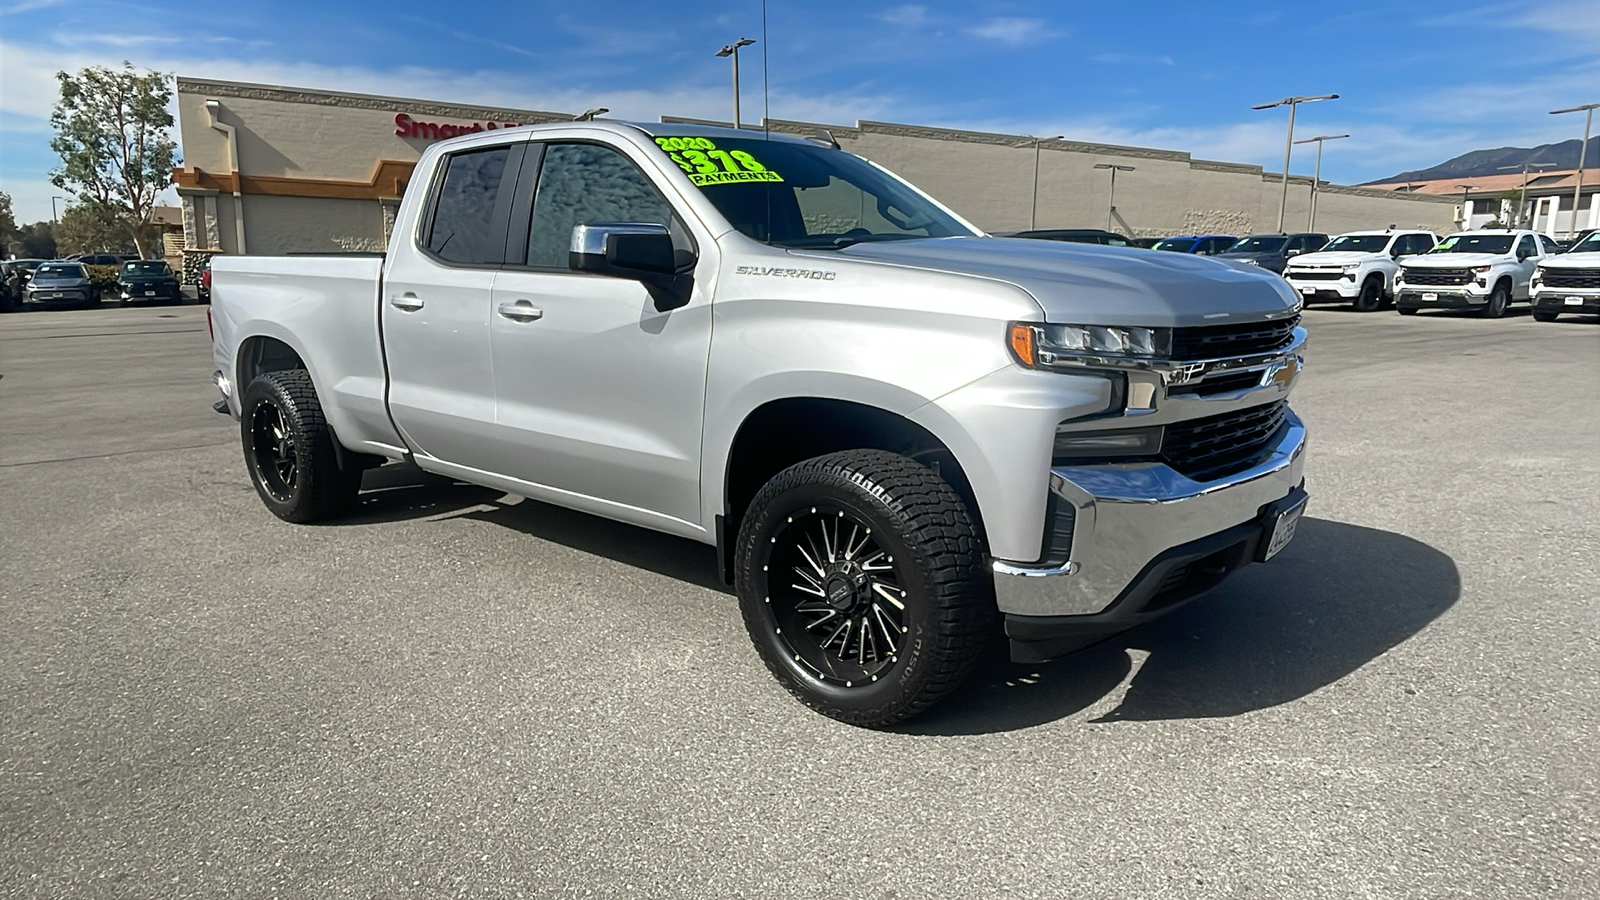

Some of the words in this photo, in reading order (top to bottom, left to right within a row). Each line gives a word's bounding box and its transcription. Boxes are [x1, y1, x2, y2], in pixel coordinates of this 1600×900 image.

[655, 137, 716, 151] 2020
[692, 172, 778, 184] PAYMENTS
[735, 265, 837, 281] SILVERADO
[899, 624, 923, 686] ARISUN
